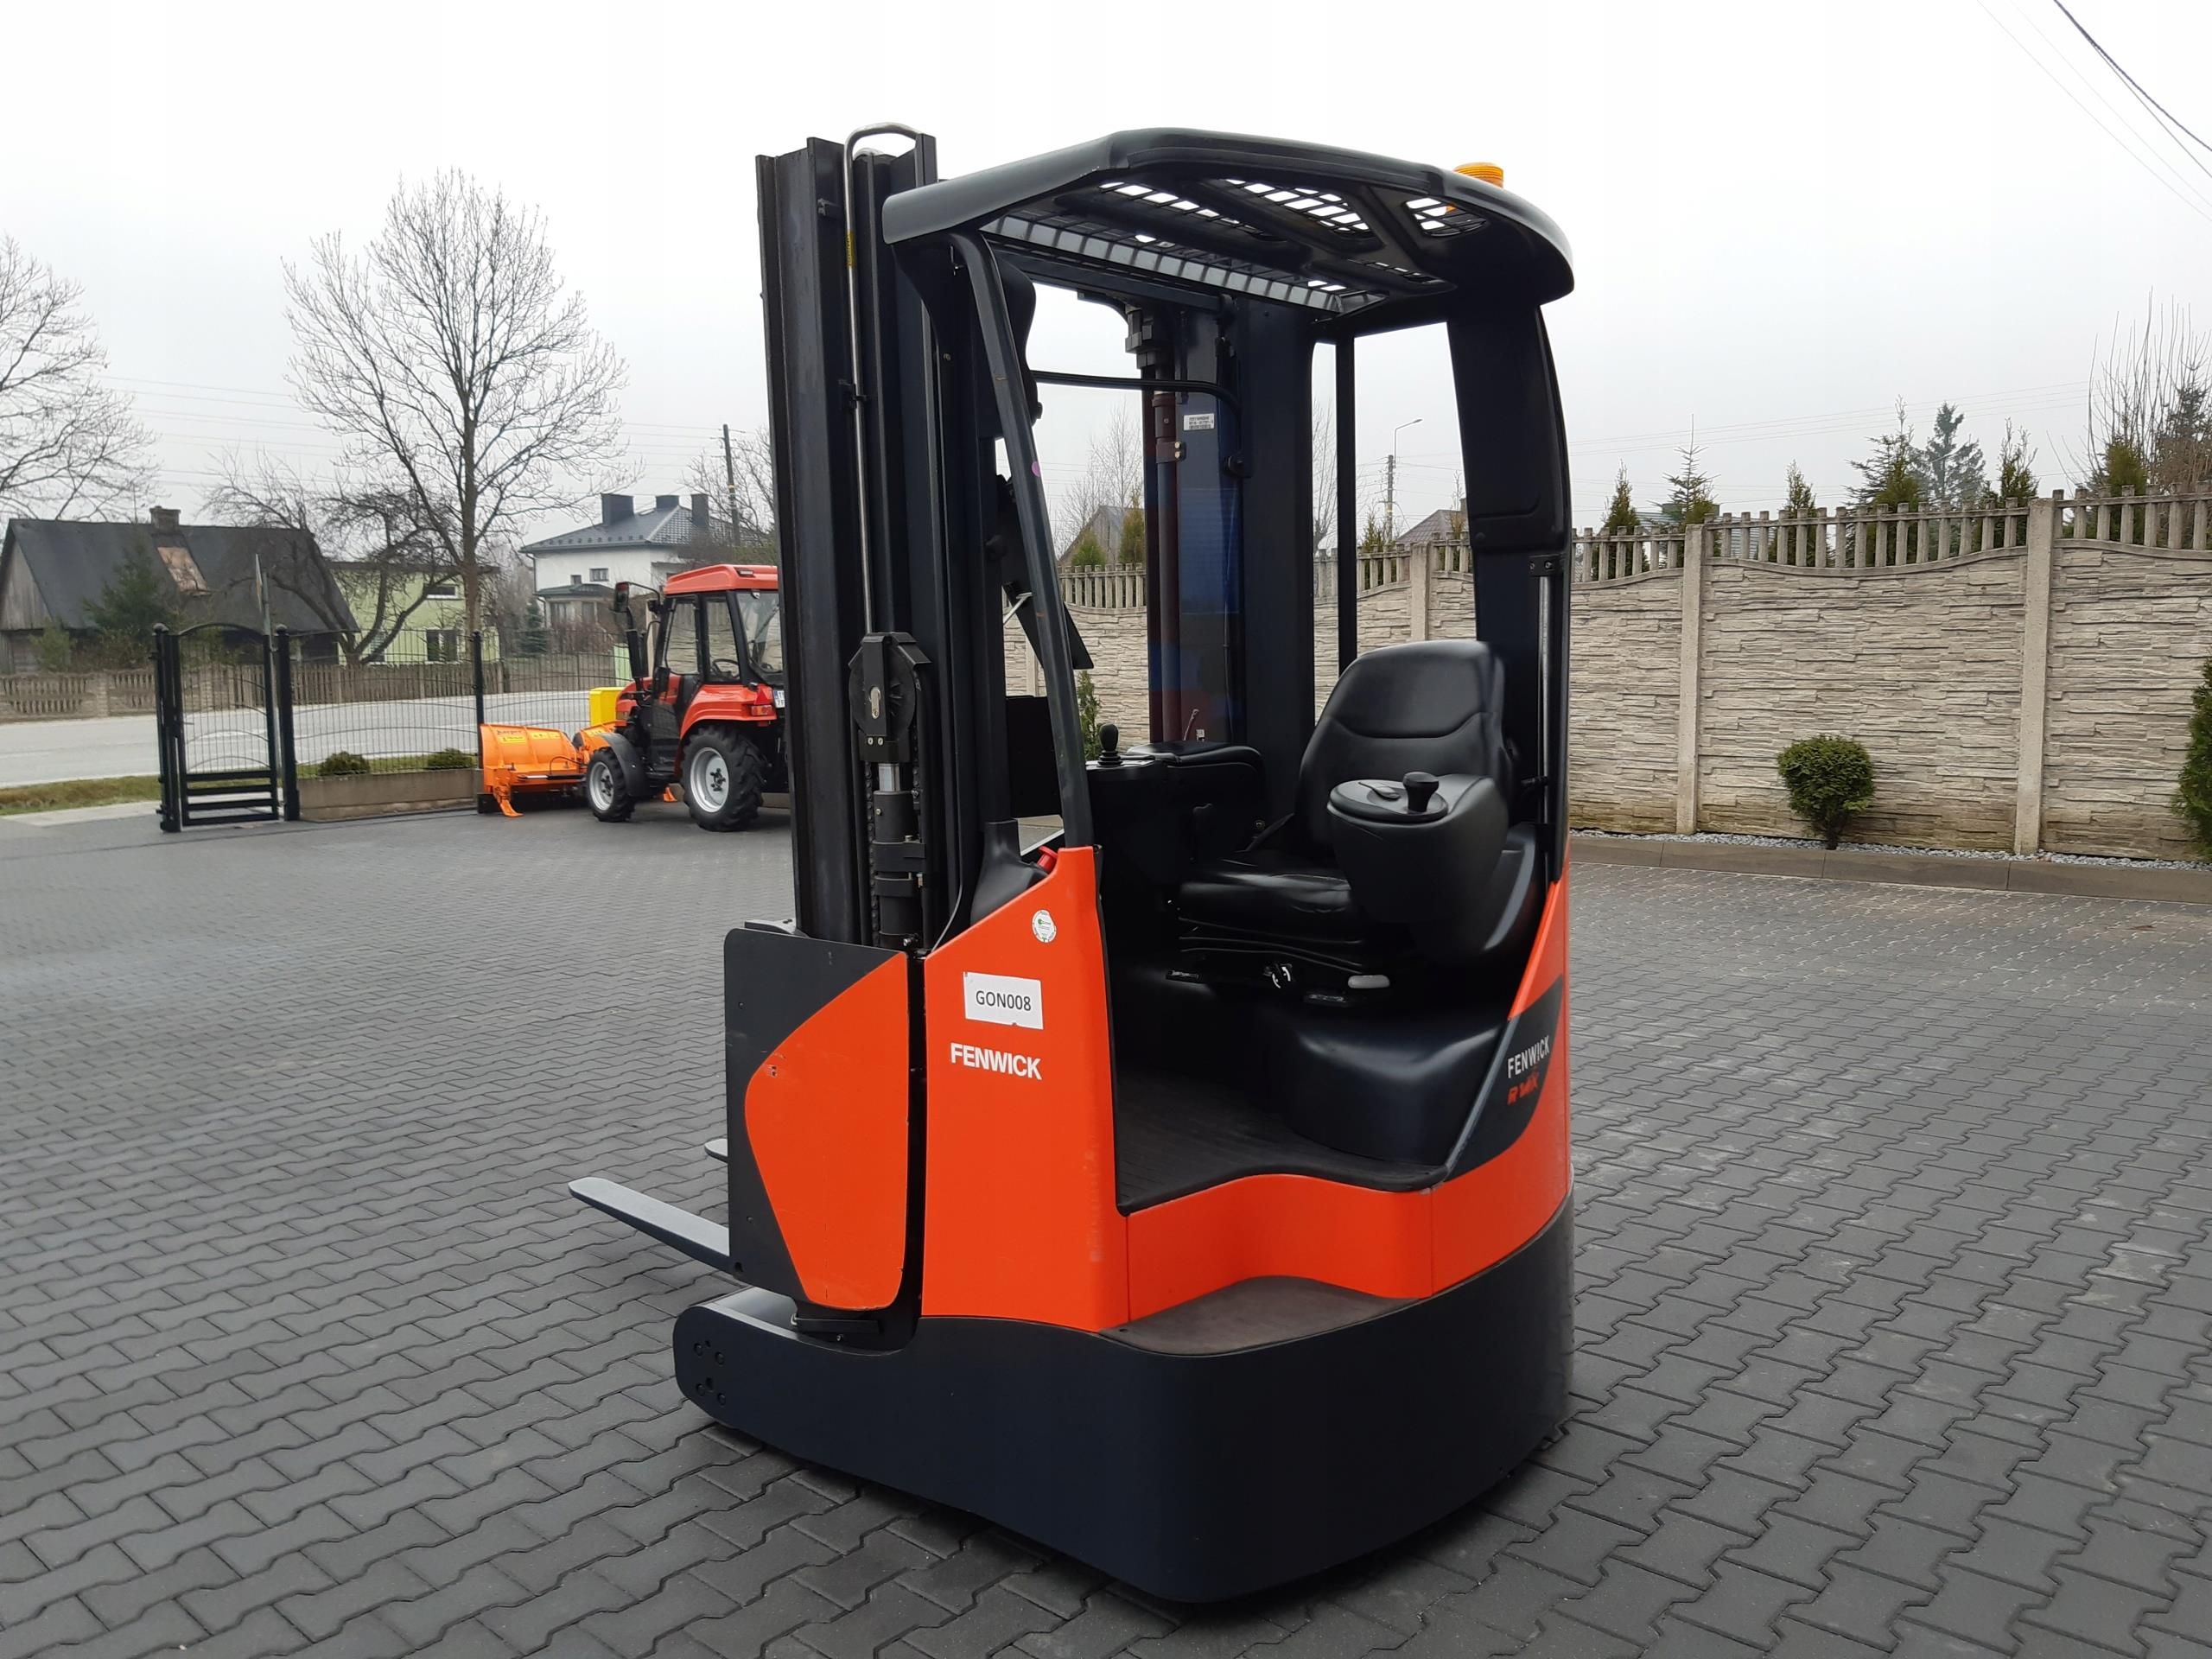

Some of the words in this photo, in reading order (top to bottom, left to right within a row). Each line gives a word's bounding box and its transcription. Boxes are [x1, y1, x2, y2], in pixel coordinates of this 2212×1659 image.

[976, 990, 1032, 1011] GON008
[950, 1042, 1042, 1080] FENWICK
[1507, 1035, 1549, 1078] FENWICK
